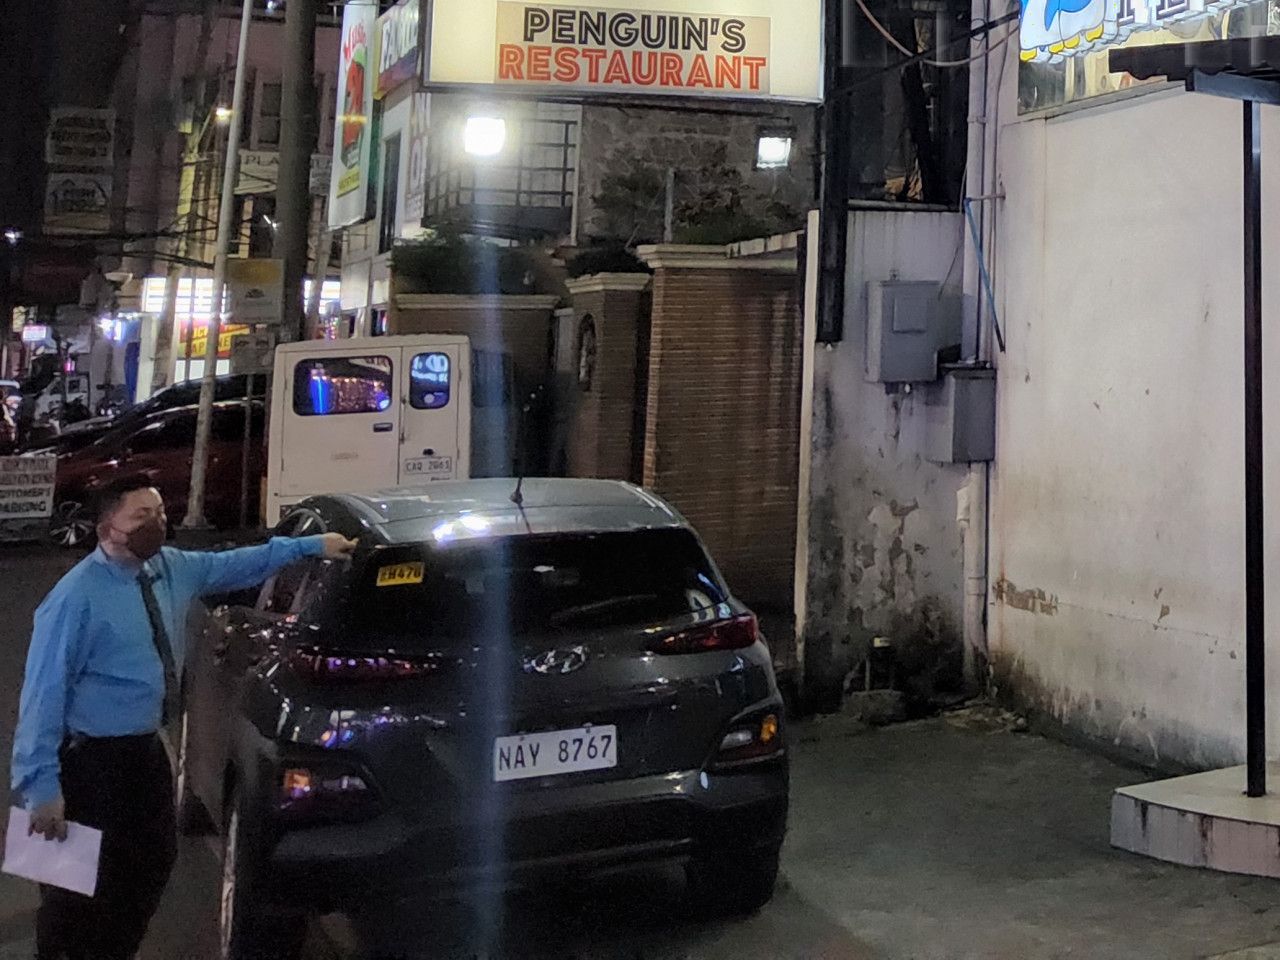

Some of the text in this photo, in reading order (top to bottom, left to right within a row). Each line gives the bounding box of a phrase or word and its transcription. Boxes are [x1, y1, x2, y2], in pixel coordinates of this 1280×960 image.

[523, 7, 746, 53] PENGUIN'S
[498, 43, 767, 90] RESTAURANT
[499, 734, 612, 772] NAY 8767
